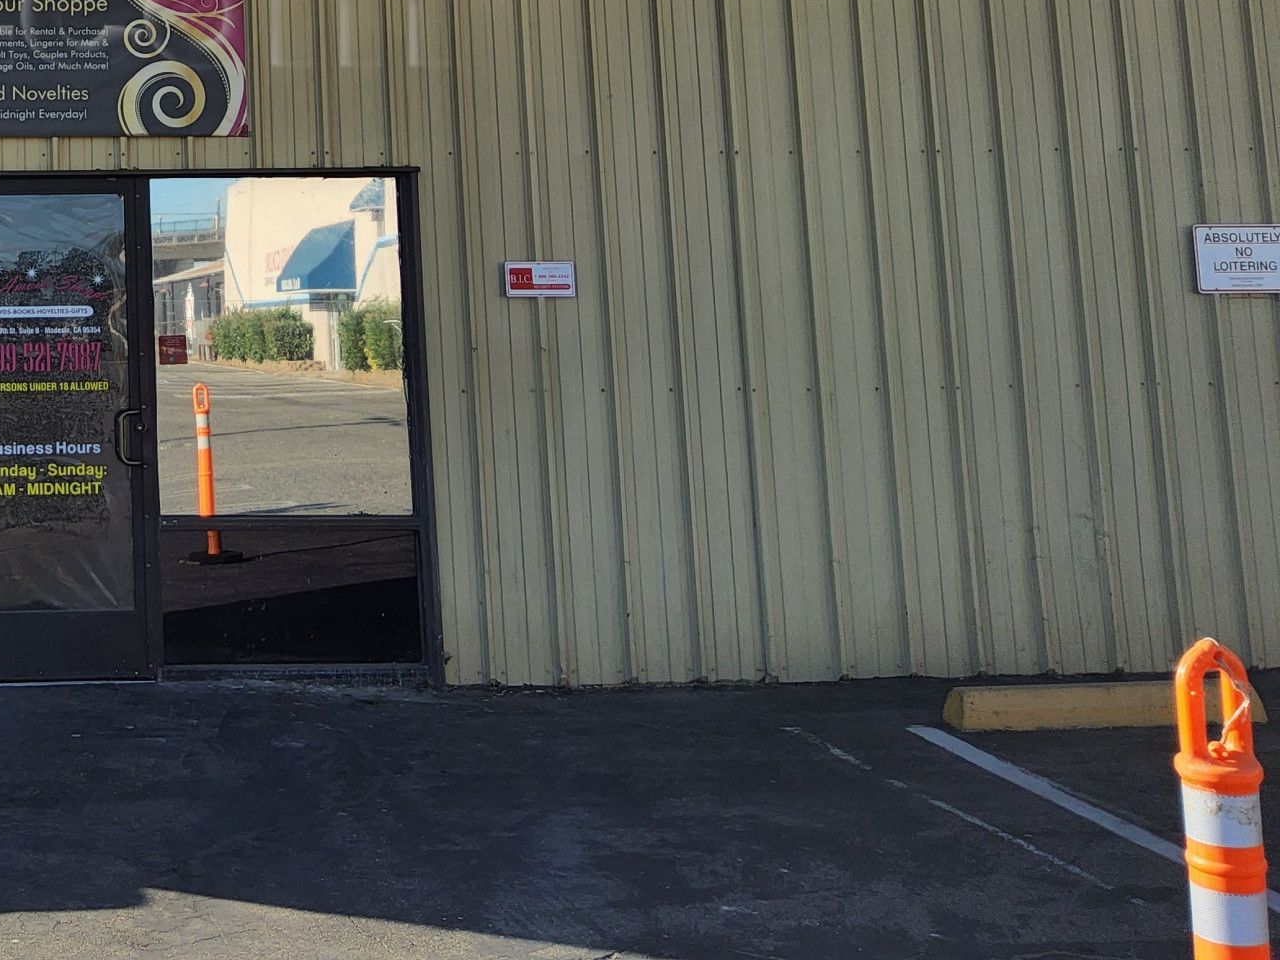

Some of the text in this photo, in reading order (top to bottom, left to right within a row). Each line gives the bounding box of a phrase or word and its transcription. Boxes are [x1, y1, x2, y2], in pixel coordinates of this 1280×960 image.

[15, 27, 28, 36] for
[29, 27, 56, 36] Rental
[58, 27, 66, 36] &
[68, 26, 109, 37] Purchase)
[29, 39, 64, 49] Lingerie
[66, 38, 78, 47] for
[80, 39, 100, 47] Men
[102, 39, 109, 47] &
[8, 50, 31, 60] Toys,
[33, 50, 69, 61] Couples
[70, 50, 110, 60] Products,
[15, 61, 36, 71] Oils,
[38, 61, 56, 70] and
[57, 61, 81, 70] Much
[83, 61, 109, 70] More!
[12, 84, 89, 101] Novelties
[38, 108, 88, 122] Everyday!
[1204, 232, 1280, 243] ABSOLUTELY
[1235, 246, 1253, 257] NO
[1213, 260, 1278, 271] LOITERING
[29, 382, 57, 391] UNDER
[59, 382, 69, 391] 18
[70, 381, 109, 391] ALLOWED
[55, 441, 102, 454] Hours
[47, 462, 108, 479] Sunday:
[26, 481, 102, 496] MIDNIGHT
